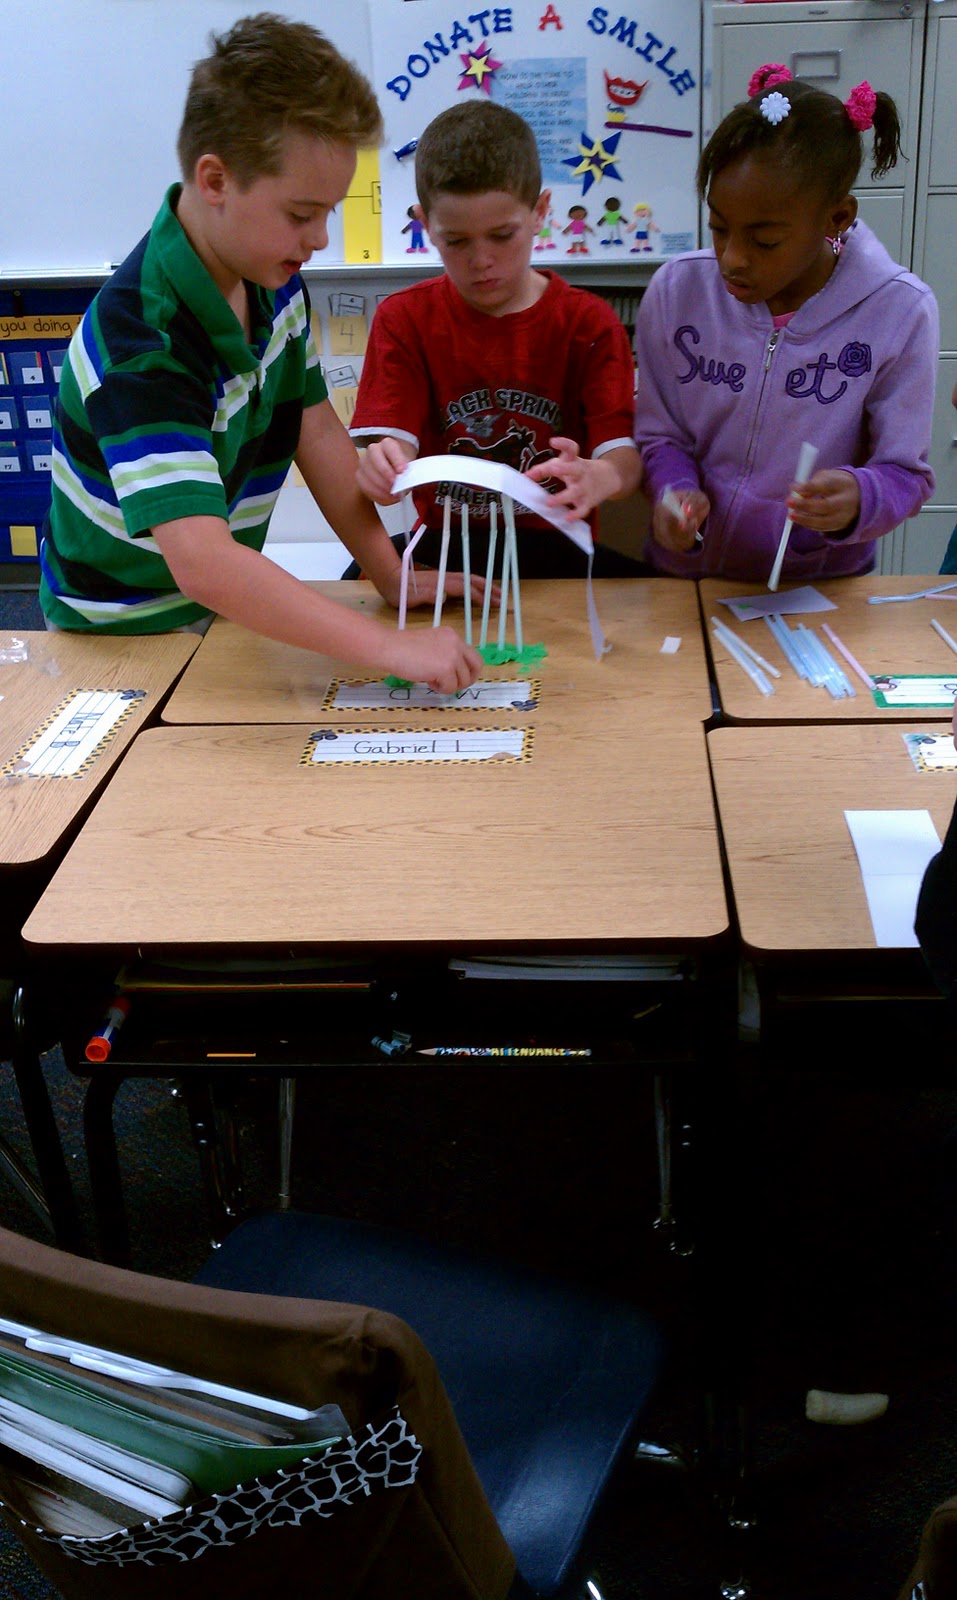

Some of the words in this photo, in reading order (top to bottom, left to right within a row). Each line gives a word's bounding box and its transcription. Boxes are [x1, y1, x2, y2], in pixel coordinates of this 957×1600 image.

[386, 7, 513, 101] DONATE
[538, 4, 563, 31] A
[587, 6, 696, 96] SMILE
[363, 249, 370, 260] 3
[0, 321, 27, 338] you
[33, 319, 73, 338] doing
[340, 323, 354, 345] 4
[49, 740, 81, 748] B
[353, 739, 436, 755] Gabriel
[456, 739, 479, 753] L
